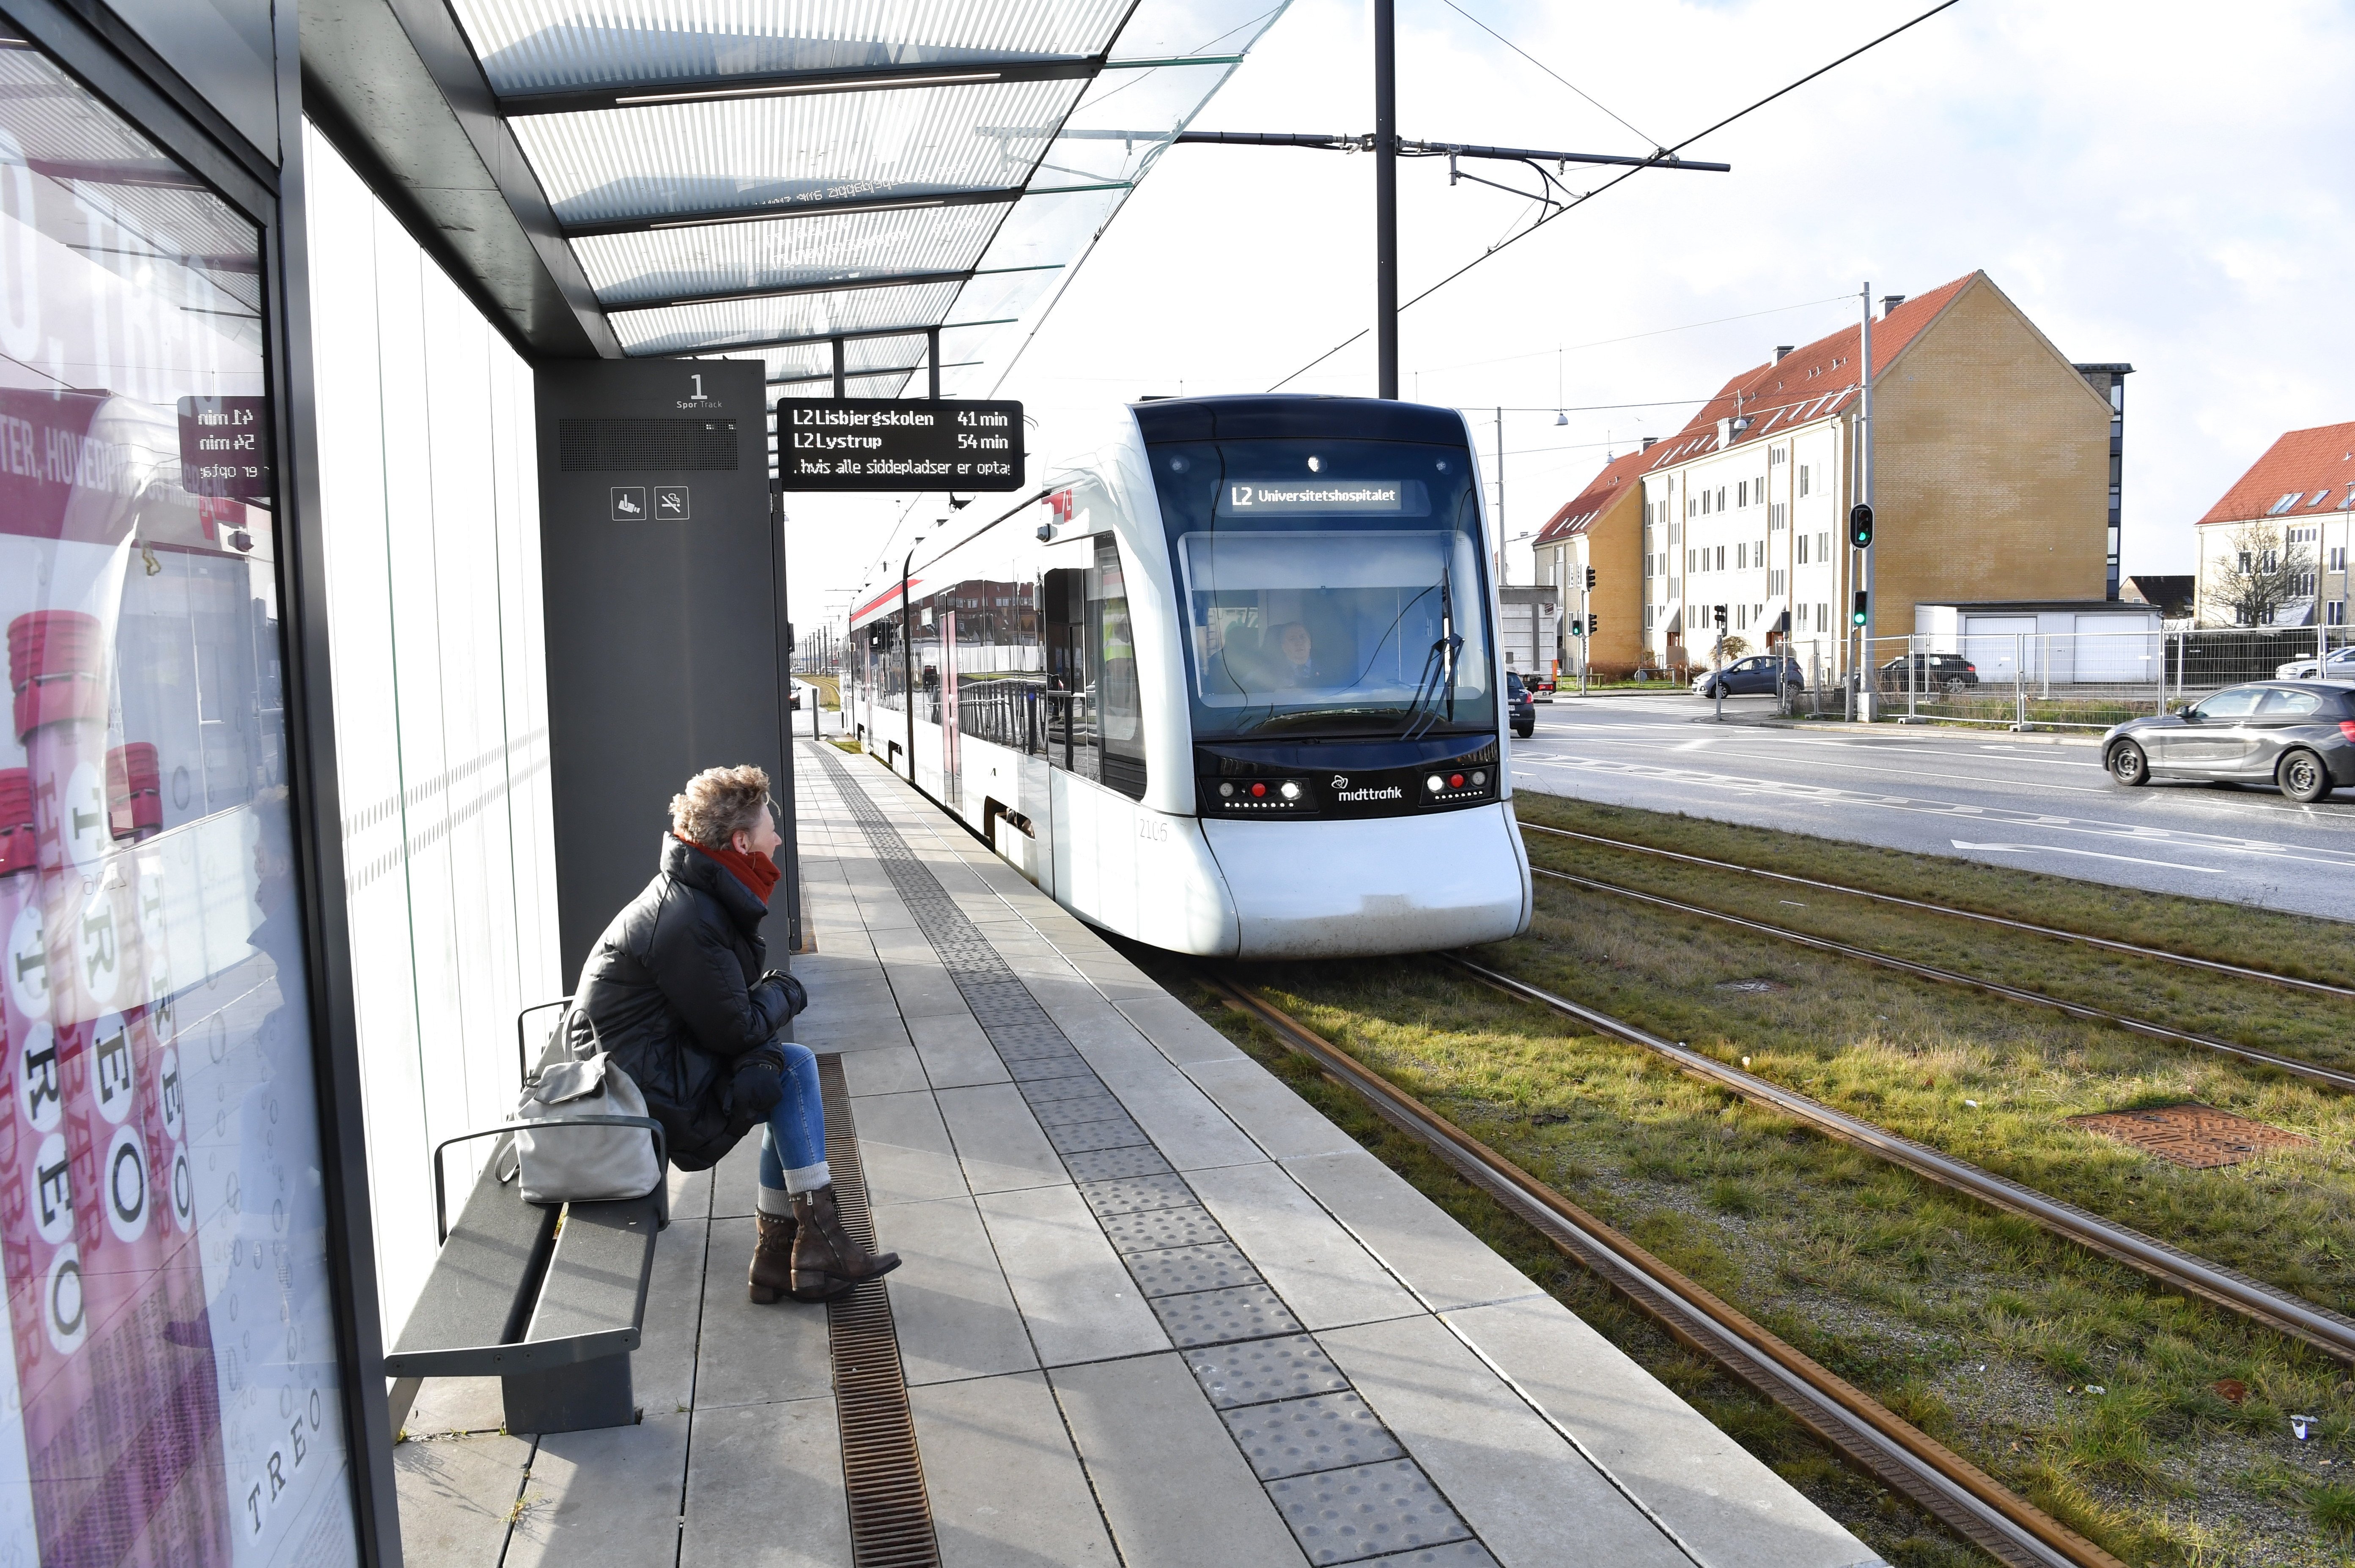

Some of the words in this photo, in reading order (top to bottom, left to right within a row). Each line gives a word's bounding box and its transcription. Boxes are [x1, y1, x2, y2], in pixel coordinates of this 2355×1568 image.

[691, 374, 708, 400] 1
[677, 401, 697, 409] Spor
[794, 410, 813, 425] L2
[816, 410, 934, 426] Lisbjergskolen
[958, 411, 977, 426] 41
[980, 411, 1008, 426] min
[794, 433, 814, 448] L2
[816, 433, 882, 449] Lystrup
[958, 433, 977, 449] 54
[980, 434, 1008, 449] min
[45, 426, 136, 496] HOVEDPIN
[835, 459, 861, 474] alle
[866, 459, 952, 475] siddepladser
[957, 463, 972, 474] er
[1232, 487, 1252, 506] L2
[1258, 489, 1396, 502] Universitetshospitalet
[1339, 786, 1403, 801] midttrafik
[1140, 819, 1167, 842] 2106
[72, 787, 145, 1223] TREO
[248, 1388, 320, 1535] TREO
